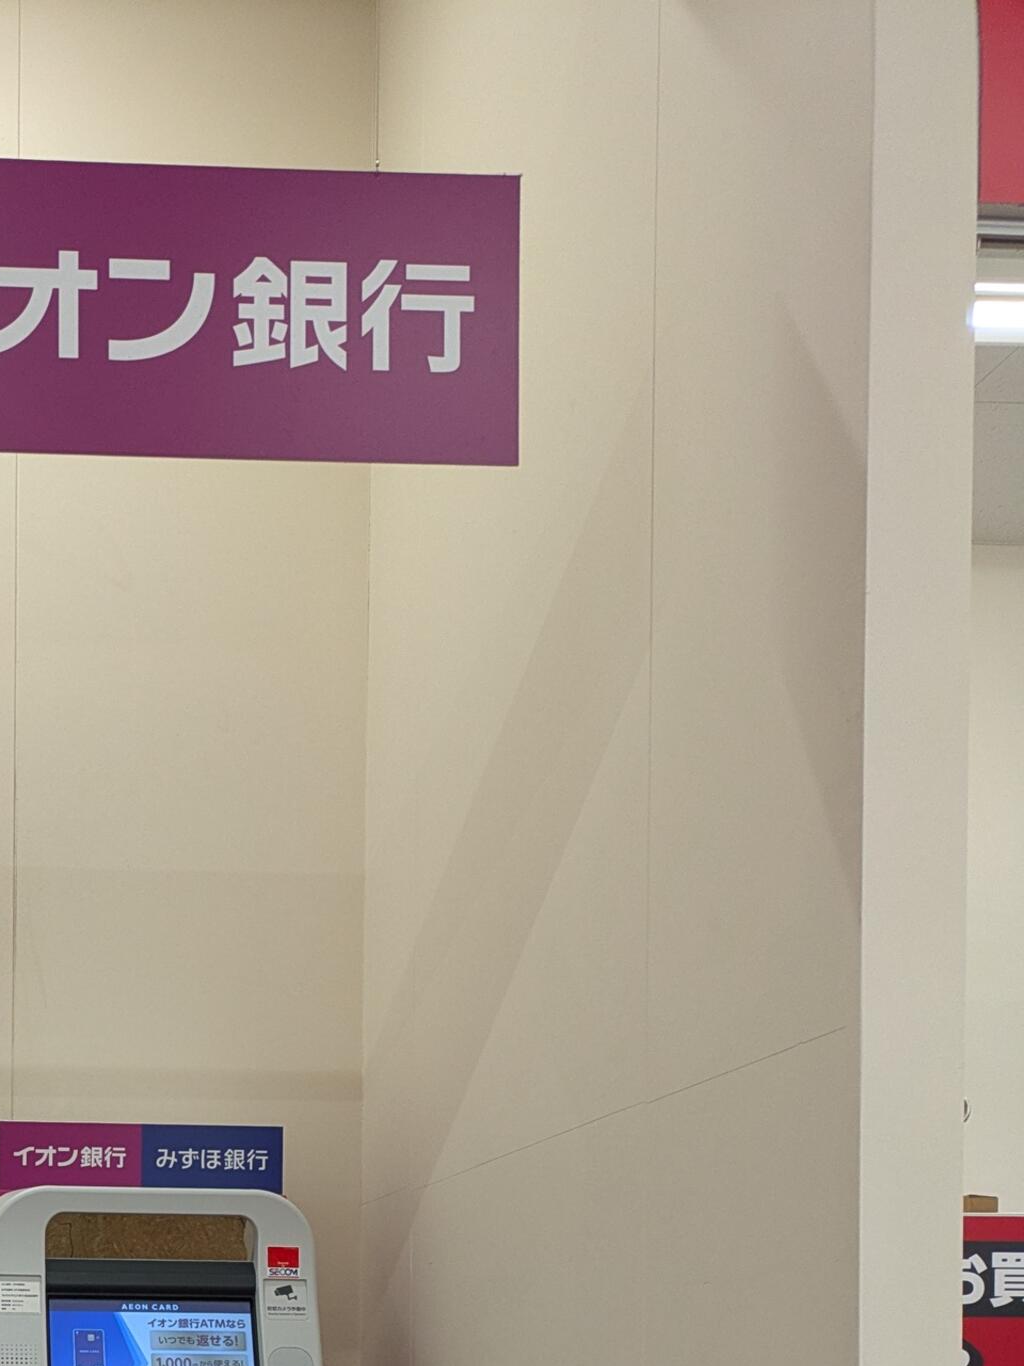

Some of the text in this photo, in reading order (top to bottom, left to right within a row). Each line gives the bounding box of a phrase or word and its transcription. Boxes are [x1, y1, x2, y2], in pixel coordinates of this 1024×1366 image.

[13, 1146, 127, 1168] イオン銀行
[155, 1148, 269, 1171] みずほ銀行
[269, 1268, 298, 1276] SECOM
[121, 1303, 180, 1312] AEON CARD
[147, 1318, 247, 1330] イオン銀行ATMなら
